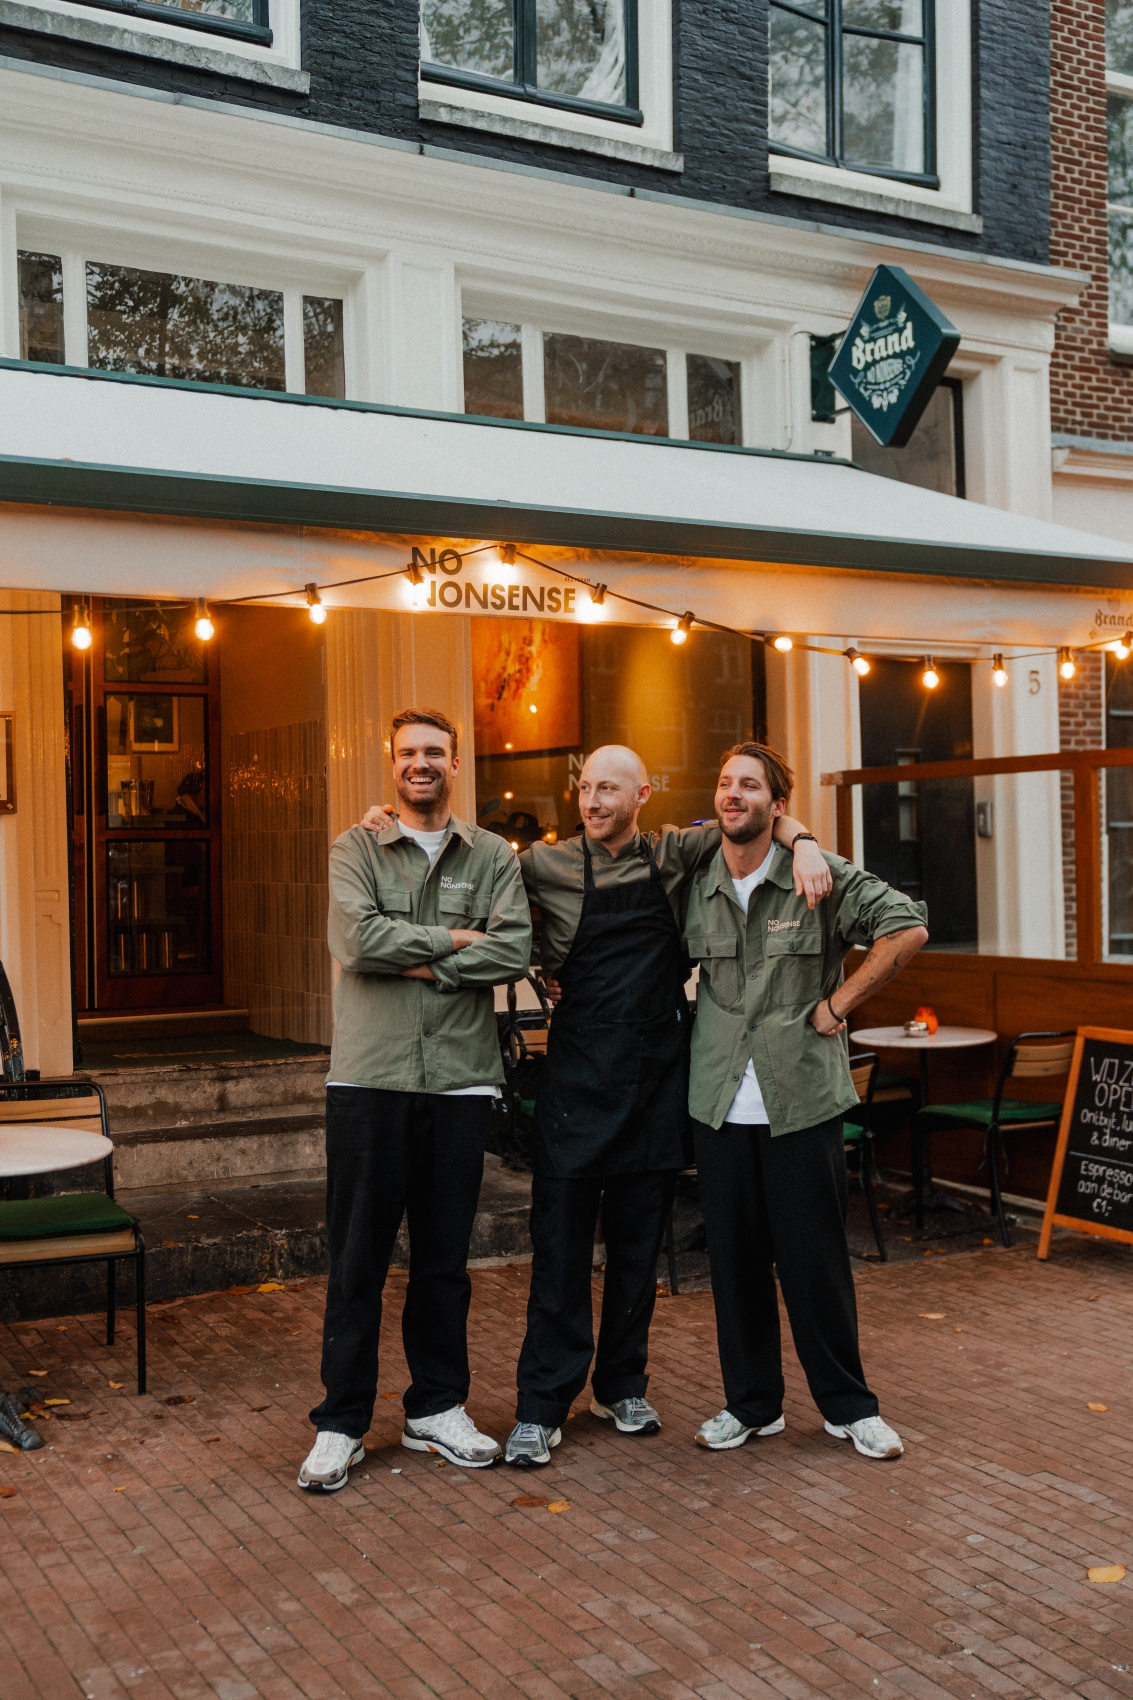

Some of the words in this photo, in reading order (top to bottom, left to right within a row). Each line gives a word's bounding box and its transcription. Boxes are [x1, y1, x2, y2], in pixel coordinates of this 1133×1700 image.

[851, 321, 915, 370] Brand
[411, 546, 463, 575] NO
[1095, 609, 1133, 627] Brand
[1029, 670, 1042, 695] 5
[568, 753, 591, 771] N
[767, 921, 800, 932] NONSENSE
[1119, 1060, 1133, 1087] Z
[1094, 1082, 1133, 1113] OPE
[1090, 1131, 1100, 1146] &
[1101, 1129, 1133, 1151] diner
[1080, 1160, 1133, 1187] Espresso
[1077, 1180, 1099, 1194] aan
[1100, 1181, 1113, 1198] de
